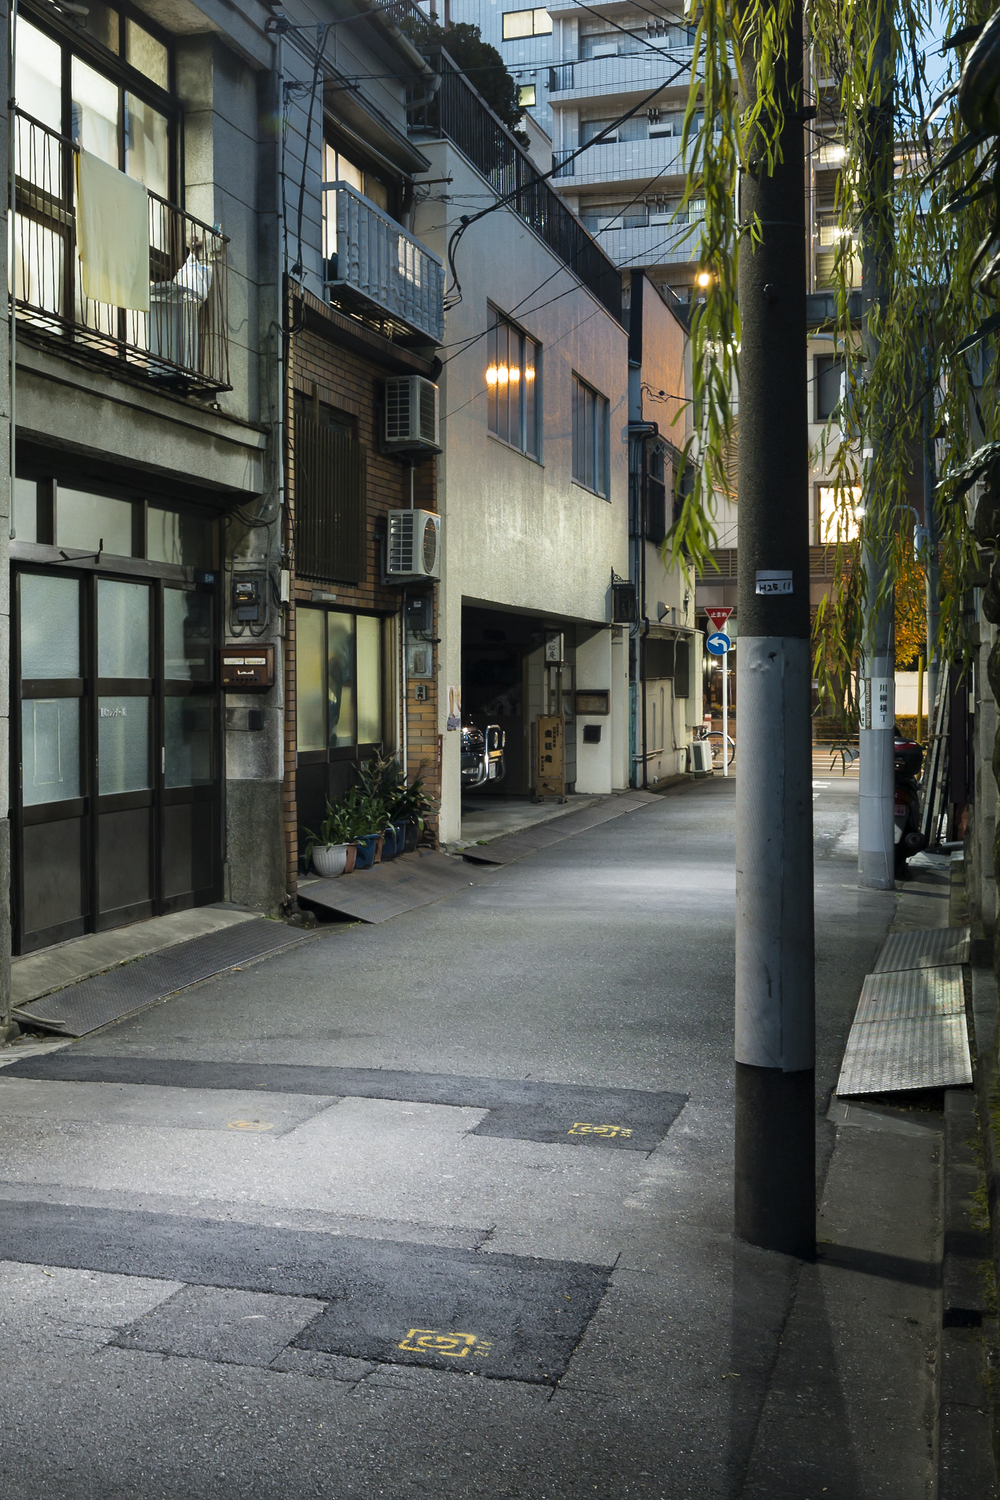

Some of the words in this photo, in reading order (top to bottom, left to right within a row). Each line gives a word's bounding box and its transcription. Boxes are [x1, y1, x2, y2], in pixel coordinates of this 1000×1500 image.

[759, 581, 791, 592] H25.11
[879, 683, 888, 722] 川柳横丁
[417, 1336, 459, 1349] G
